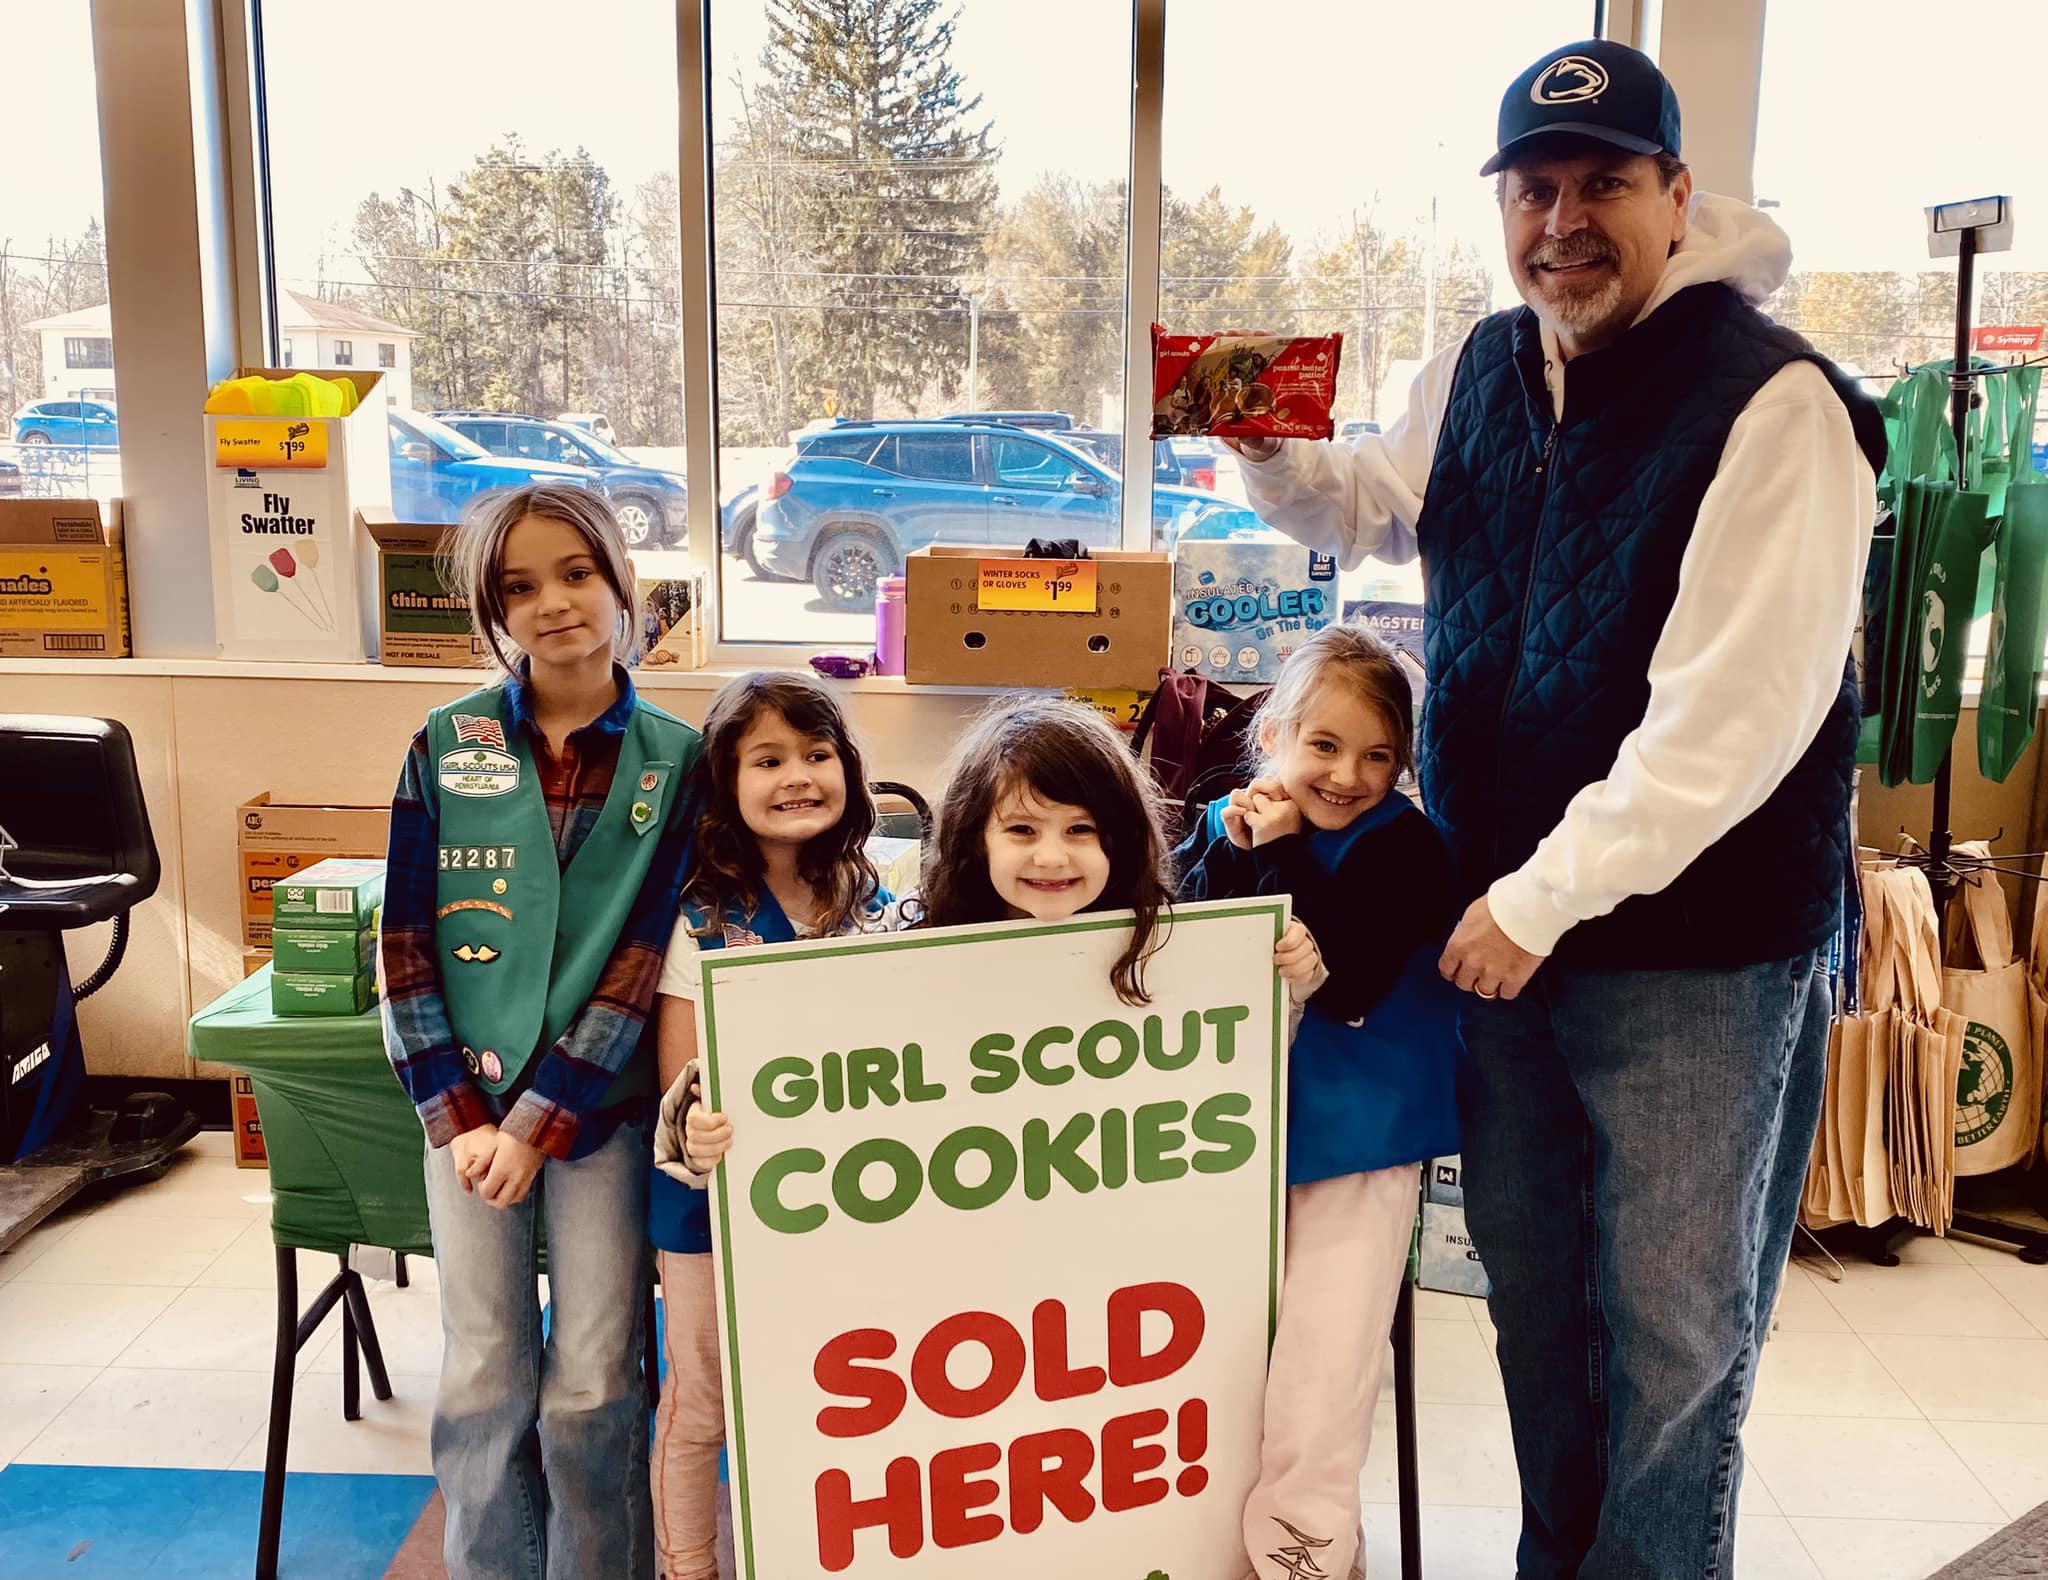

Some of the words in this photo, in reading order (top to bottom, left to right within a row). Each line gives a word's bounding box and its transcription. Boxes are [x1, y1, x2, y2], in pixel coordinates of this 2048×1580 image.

[1996, 336, 2037, 346] Synergy
[220, 438, 230, 447] Fly
[233, 438, 261, 446] Swatter
[263, 493, 290, 515] Fly
[241, 513, 316, 535] Swatter
[982, 580, 994, 588] OR
[996, 581, 1027, 589] GLOVES
[983, 570, 1013, 578] WINTER
[1014, 571, 1041, 579] SOCKS
[391, 591, 428, 609] thin
[1185, 583, 1255, 600] INSULATED
[53, 599, 89, 607] FLAVORED
[1186, 586, 1325, 626] COOLER
[1255, 626, 1275, 641] On
[1276, 619, 1300, 633] The
[385, 651, 399, 659] NOT
[416, 652, 441, 660] RESALE
[462, 762, 498, 771] SCOUTS
[454, 782, 500, 790] PENNSYLVANIA
[439, 848, 516, 868] 52287
[1974, 1026, 2005, 1050] PLANET
[752, 1042, 947, 1119] GIRL
[969, 1004, 1250, 1095] SCOUT
[1956, 1122, 1995, 1145] BETTER
[750, 1092, 1257, 1234] COOKIES
[813, 1281, 1206, 1438] SOLD
[814, 1397, 1209, 1572] HERE!
